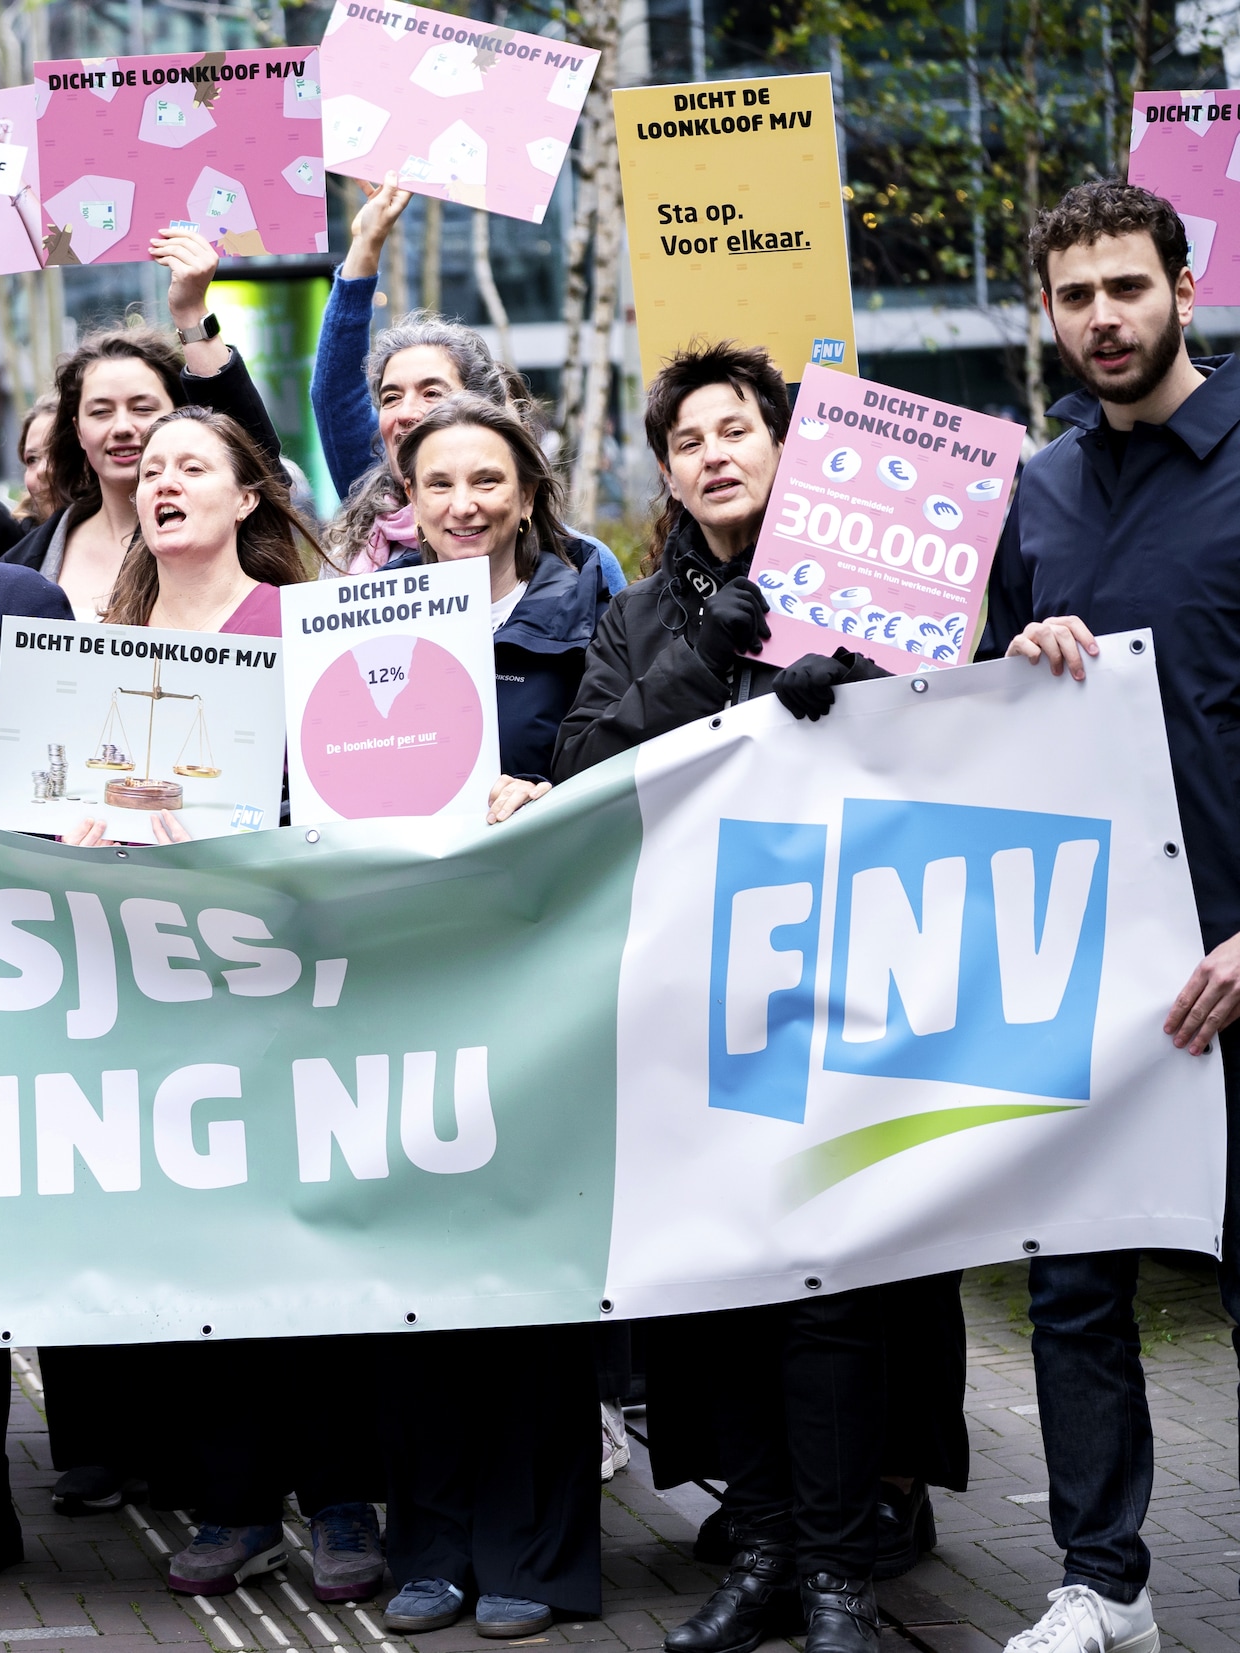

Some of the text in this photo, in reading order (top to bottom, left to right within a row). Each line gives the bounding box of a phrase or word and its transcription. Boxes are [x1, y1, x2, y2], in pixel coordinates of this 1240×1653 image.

[347, 3, 584, 72] DICHT DE LOONKLOOF M/V
[48, 61, 306, 91] DICHT DE LOONKLOOF M/V
[674, 88, 770, 111] DICHT DE
[1146, 105, 1202, 123] DICHT
[1207, 104, 1232, 121] DE
[637, 111, 812, 140] LOONKLOOF M/V
[657, 204, 744, 225] Sta op.
[660, 229, 811, 256] Voor elkaar.
[813, 343, 844, 358] FNV
[863, 390, 963, 433] DICHT DE
[817, 402, 997, 468] LOONKLOOF M/V
[790, 477, 894, 514] Vrouwen lopen gemiddeld
[775, 492, 979, 586] 300.000
[338, 574, 429, 604] DICHT DE
[837, 561, 968, 604] euro mis in hun werkende leven.
[302, 595, 469, 634] LOONKLOOF M/V
[15, 631, 277, 669] DICHT DE LOONKLOOF M/V
[368, 666, 405, 685] 12%
[326, 732, 437, 755] De loonkloof per uur
[233, 808, 264, 825] FNV
[725, 839, 1100, 1056] FNV
[292, 1046, 498, 1182] NU
